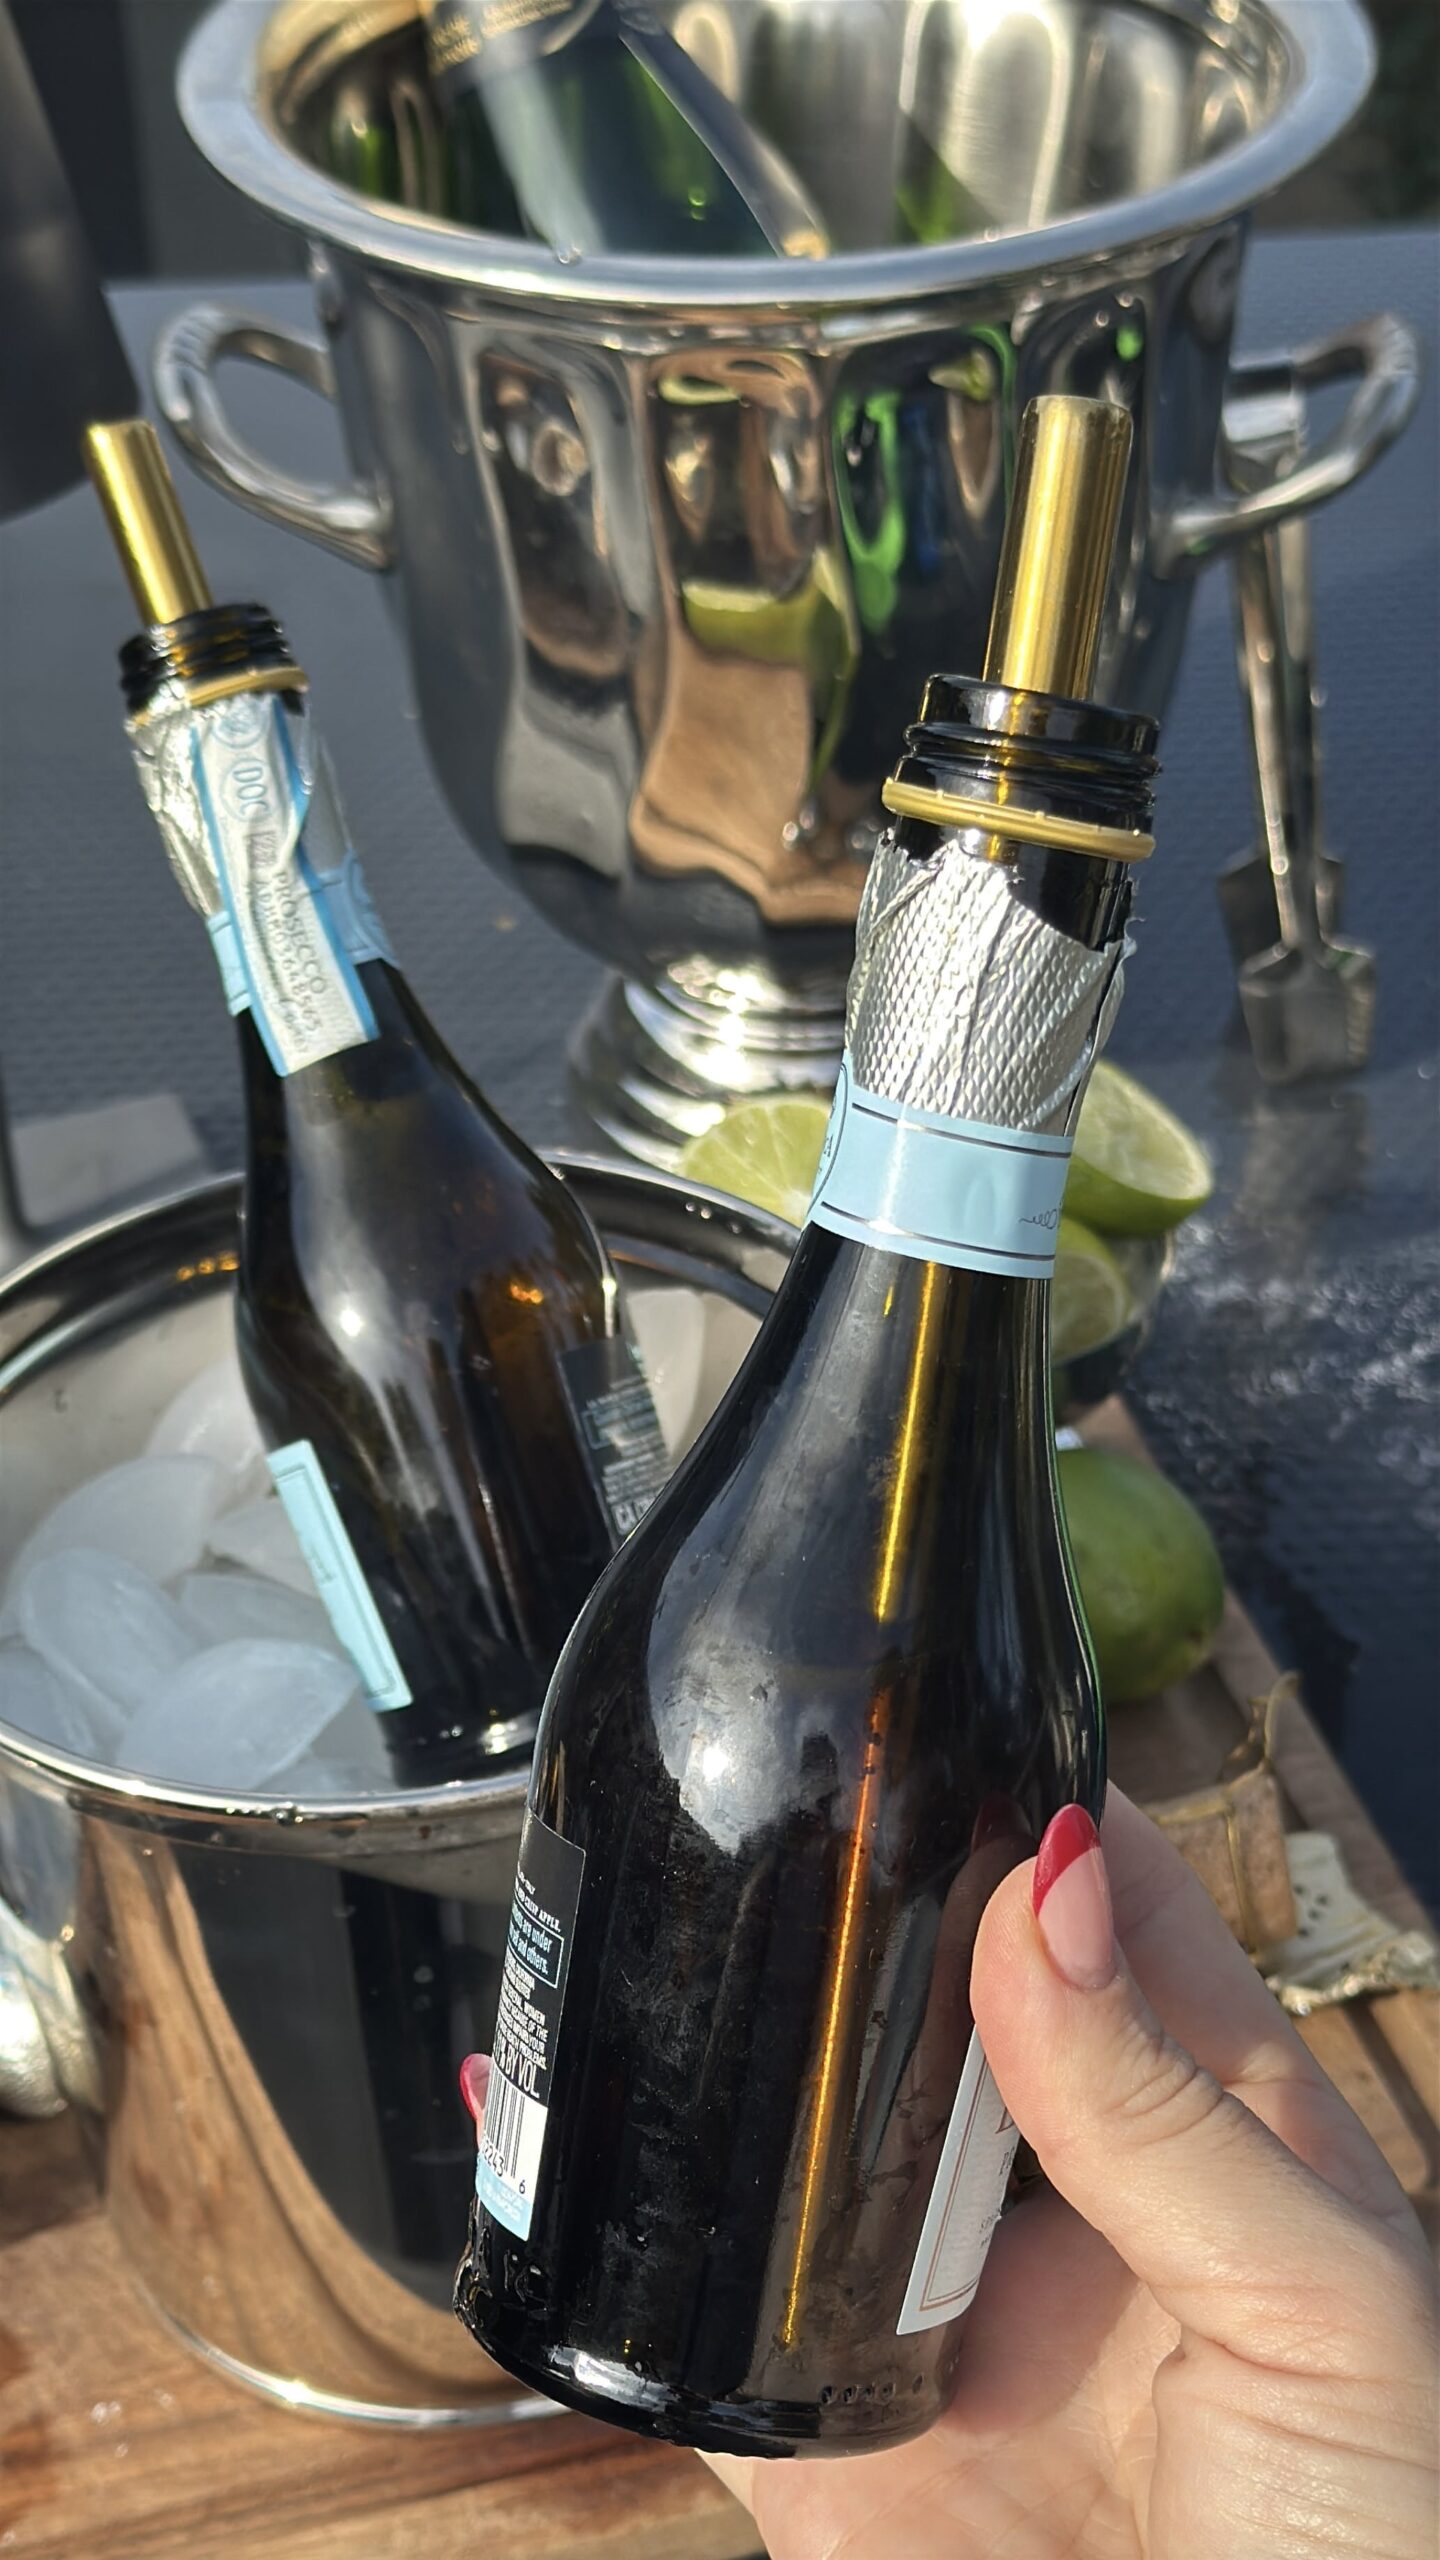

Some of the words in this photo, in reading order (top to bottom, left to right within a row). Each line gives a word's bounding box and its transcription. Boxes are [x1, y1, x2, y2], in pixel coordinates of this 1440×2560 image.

[233, 767, 270, 817] DOC
[273, 871, 327, 995] PROSECCO
[539, 1909, 561, 1933] APPLE.
[532, 1927, 553, 1953] under
[527, 1946, 548, 1975] others.
[528, 2019, 536, 2033] OF
[536, 2026, 549, 2042] THE
[529, 2036, 545, 2054] YOUR
[505, 2044, 519, 2080] BY
[518, 2052, 540, 2099] VOL.
[518, 2179, 526, 2195] 6
